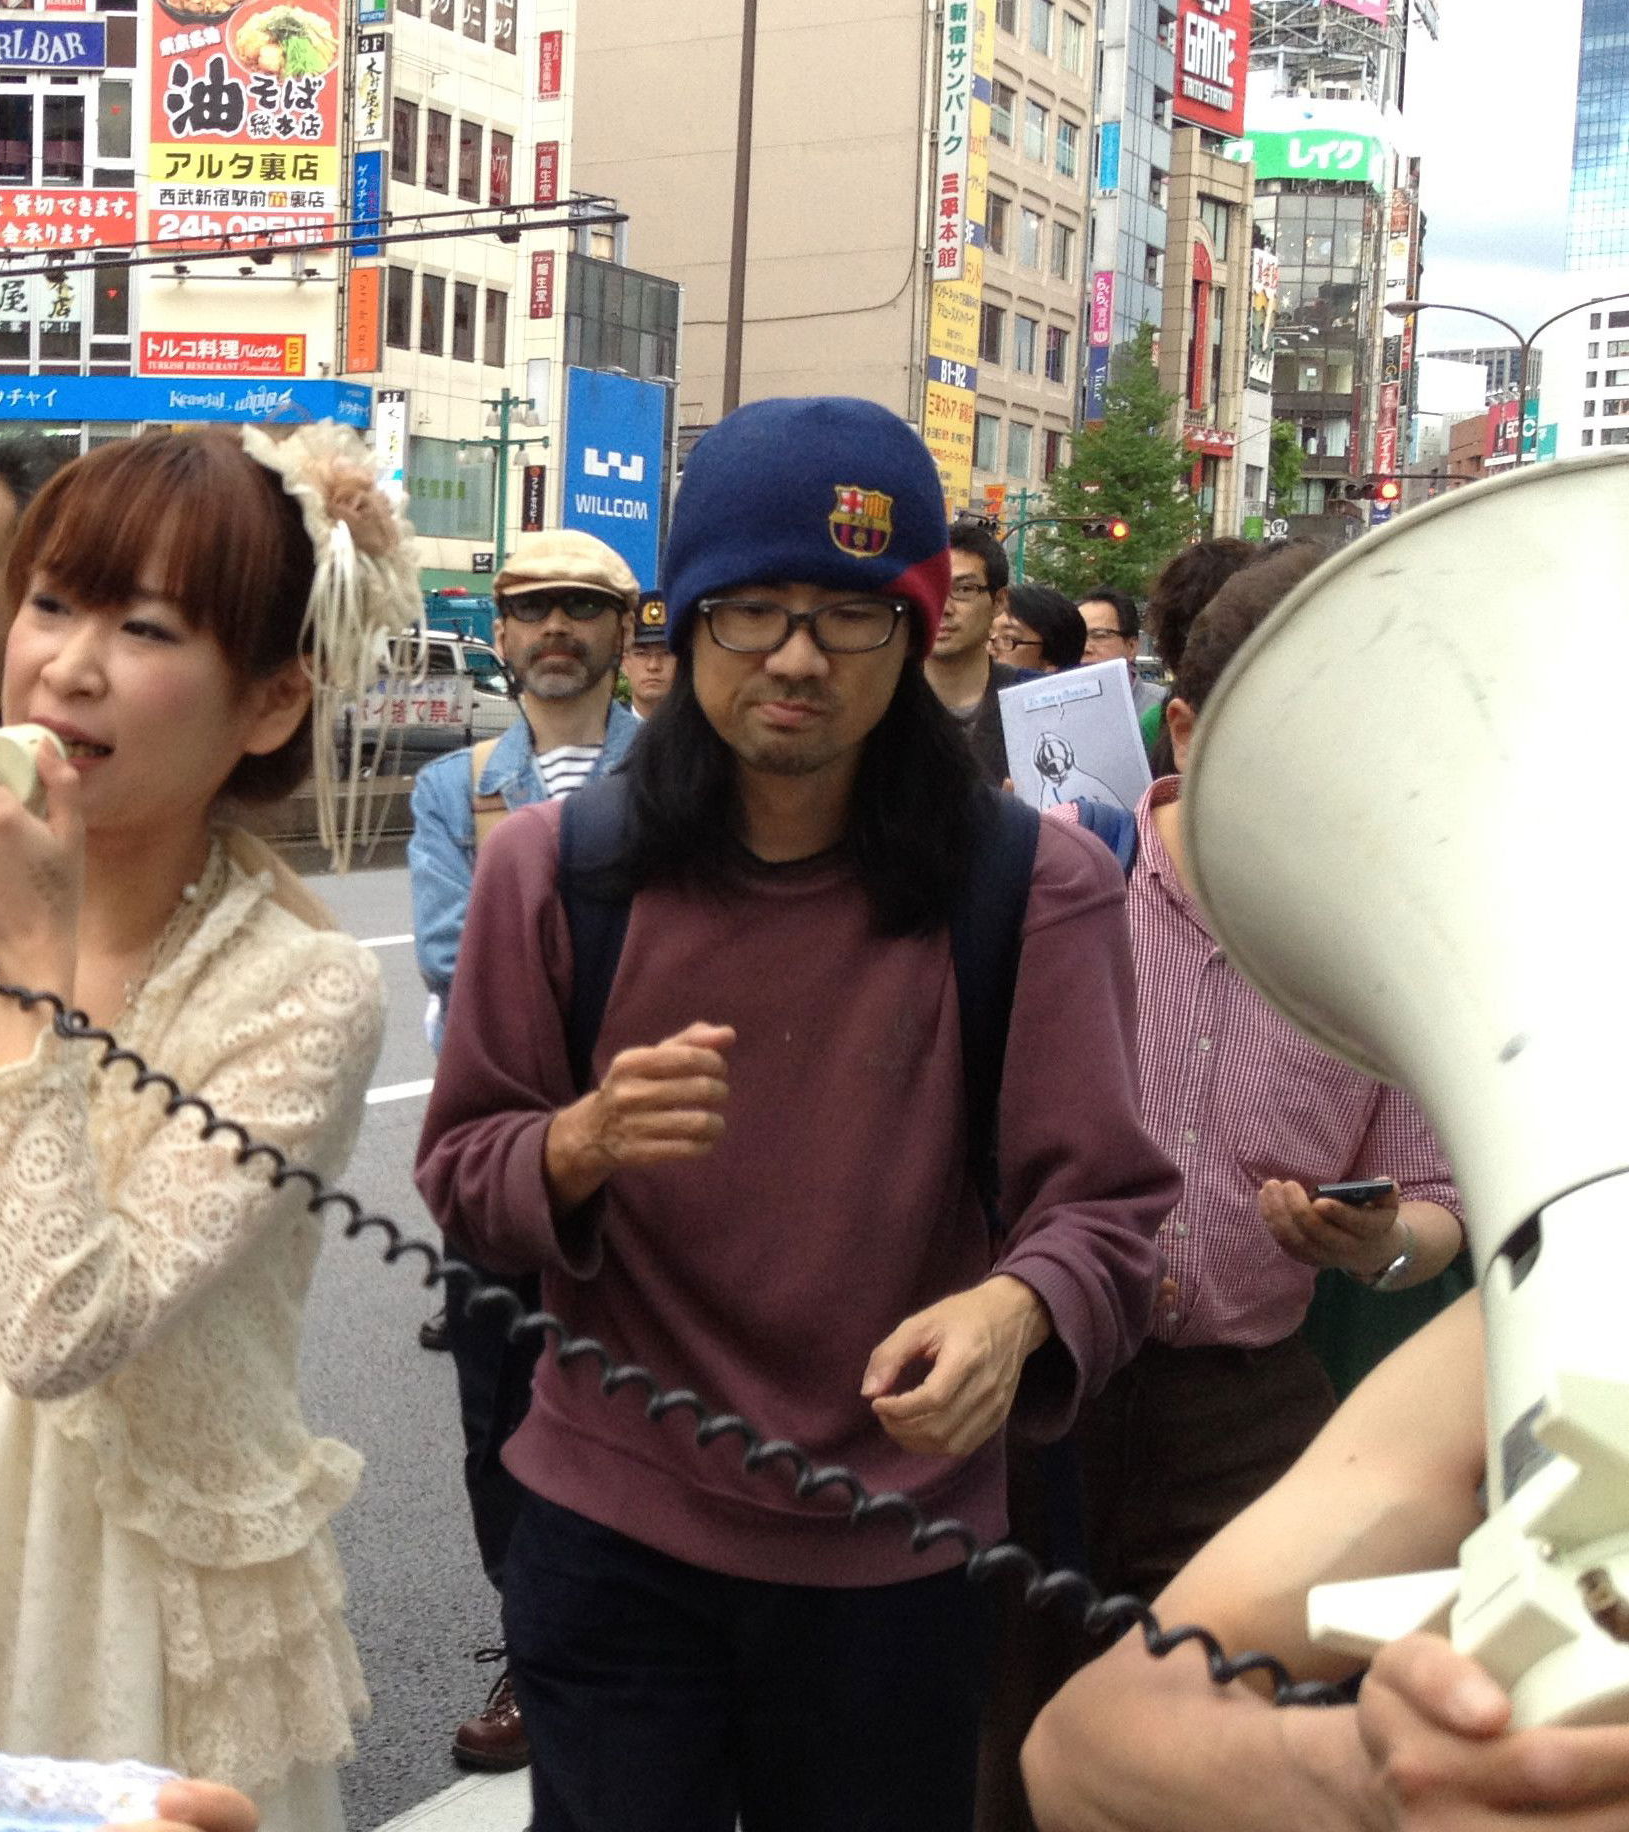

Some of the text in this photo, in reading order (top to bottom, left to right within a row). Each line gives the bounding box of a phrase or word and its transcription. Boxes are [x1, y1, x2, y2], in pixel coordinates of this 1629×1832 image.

[28, 30, 86, 64] BAR
[360, 37, 382, 52] 3F
[1183, 11, 1237, 89] GAME
[166, 56, 323, 135] 油 そば
[165, 152, 320, 182] アルタ裏店
[1287, 138, 1365, 170] レイク
[13, 194, 135, 220] 貸切できます。
[159, 188, 266, 208] 西武新宿駅前
[158, 213, 223, 244] 24h
[147, 336, 240, 360] トルコ料理
[575, 493, 649, 521] WILLCOM
